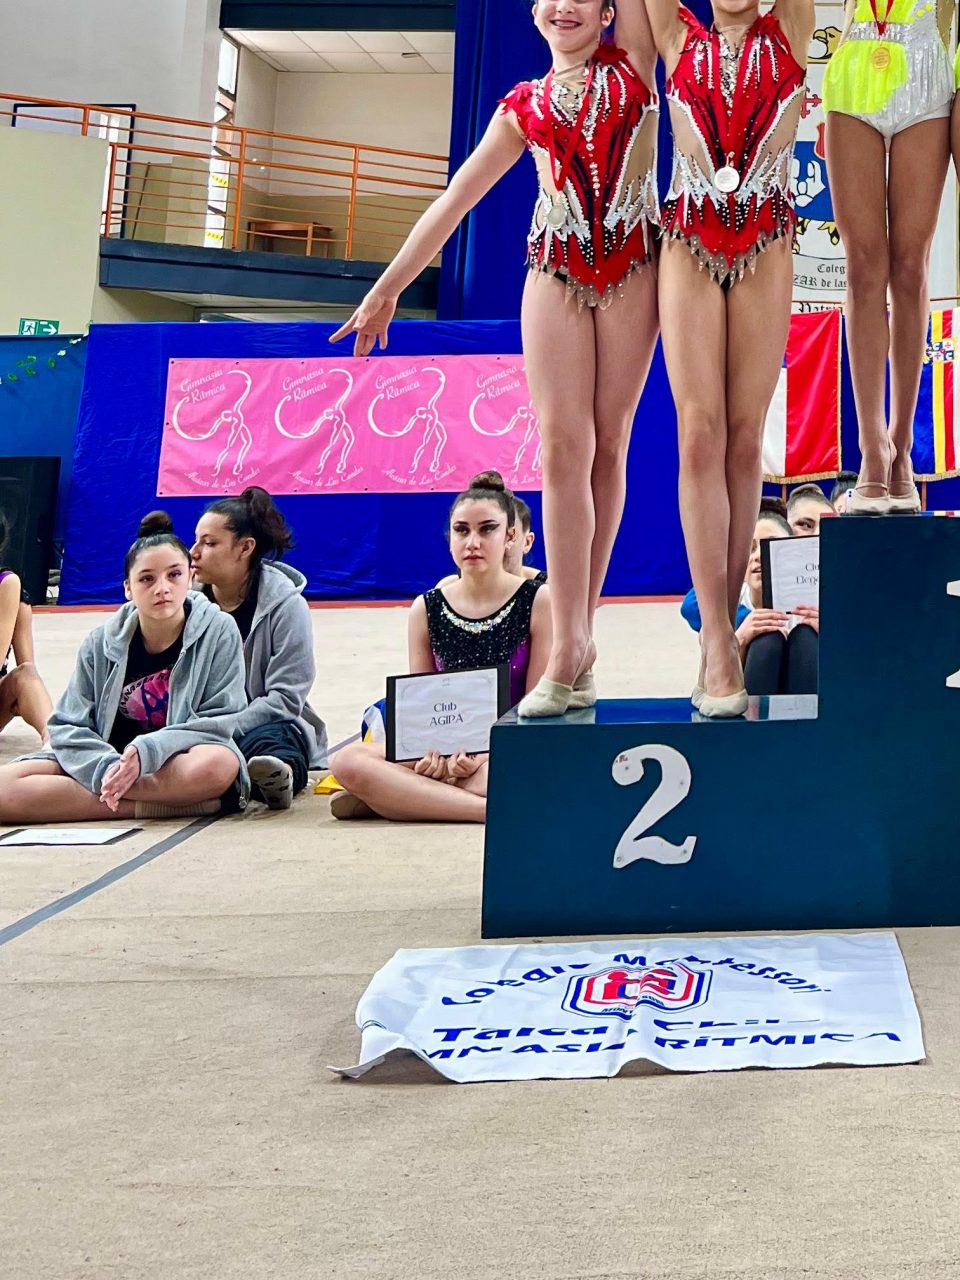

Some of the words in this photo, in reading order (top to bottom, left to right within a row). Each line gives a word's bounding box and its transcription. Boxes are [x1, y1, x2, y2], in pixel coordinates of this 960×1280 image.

[793, 274, 817, 286] ZAR
[821, 279, 831, 287] de
[817, 264, 846, 274] Coleg
[181, 370, 223, 394] Gimnasia
[282, 369, 324, 392] Gimnasia
[376, 367, 417, 392] Gimnasia
[476, 366, 517, 391] Gimnasia
[434, 702, 457, 713] Club
[430, 714, 464, 727] AGIPA
[611, 744, 697, 868] 2
